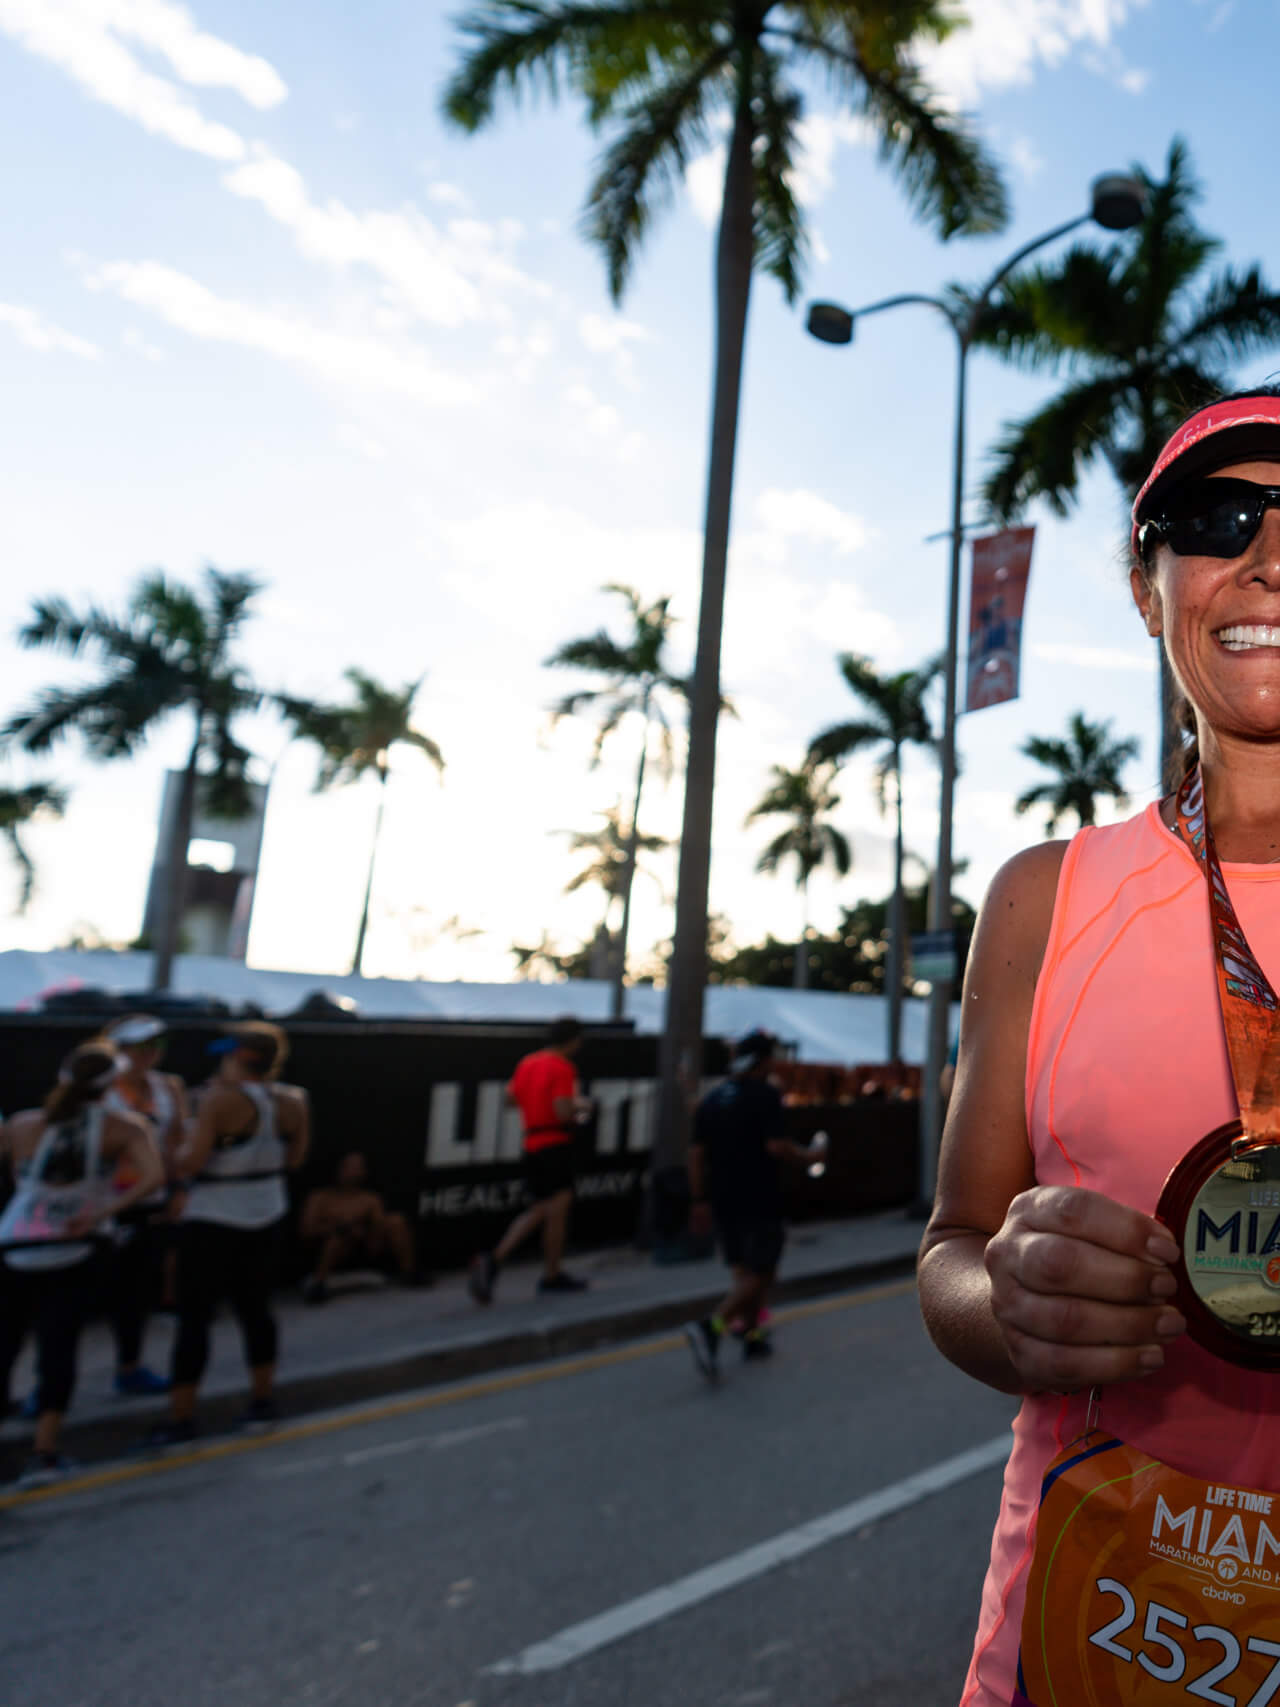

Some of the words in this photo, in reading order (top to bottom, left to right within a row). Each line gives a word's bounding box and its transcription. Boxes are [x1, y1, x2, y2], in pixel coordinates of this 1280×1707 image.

[418, 1178, 530, 1218] HEALT
[1194, 1256, 1264, 1271] MARATHON
[1205, 1486, 1236, 1508] LIFE
[1237, 1490, 1274, 1515] TIME
[1149, 1540, 1215, 1570] MARATHON
[1241, 1566, 1272, 1583] AND
[1201, 1585, 1246, 1606] cbdMD
